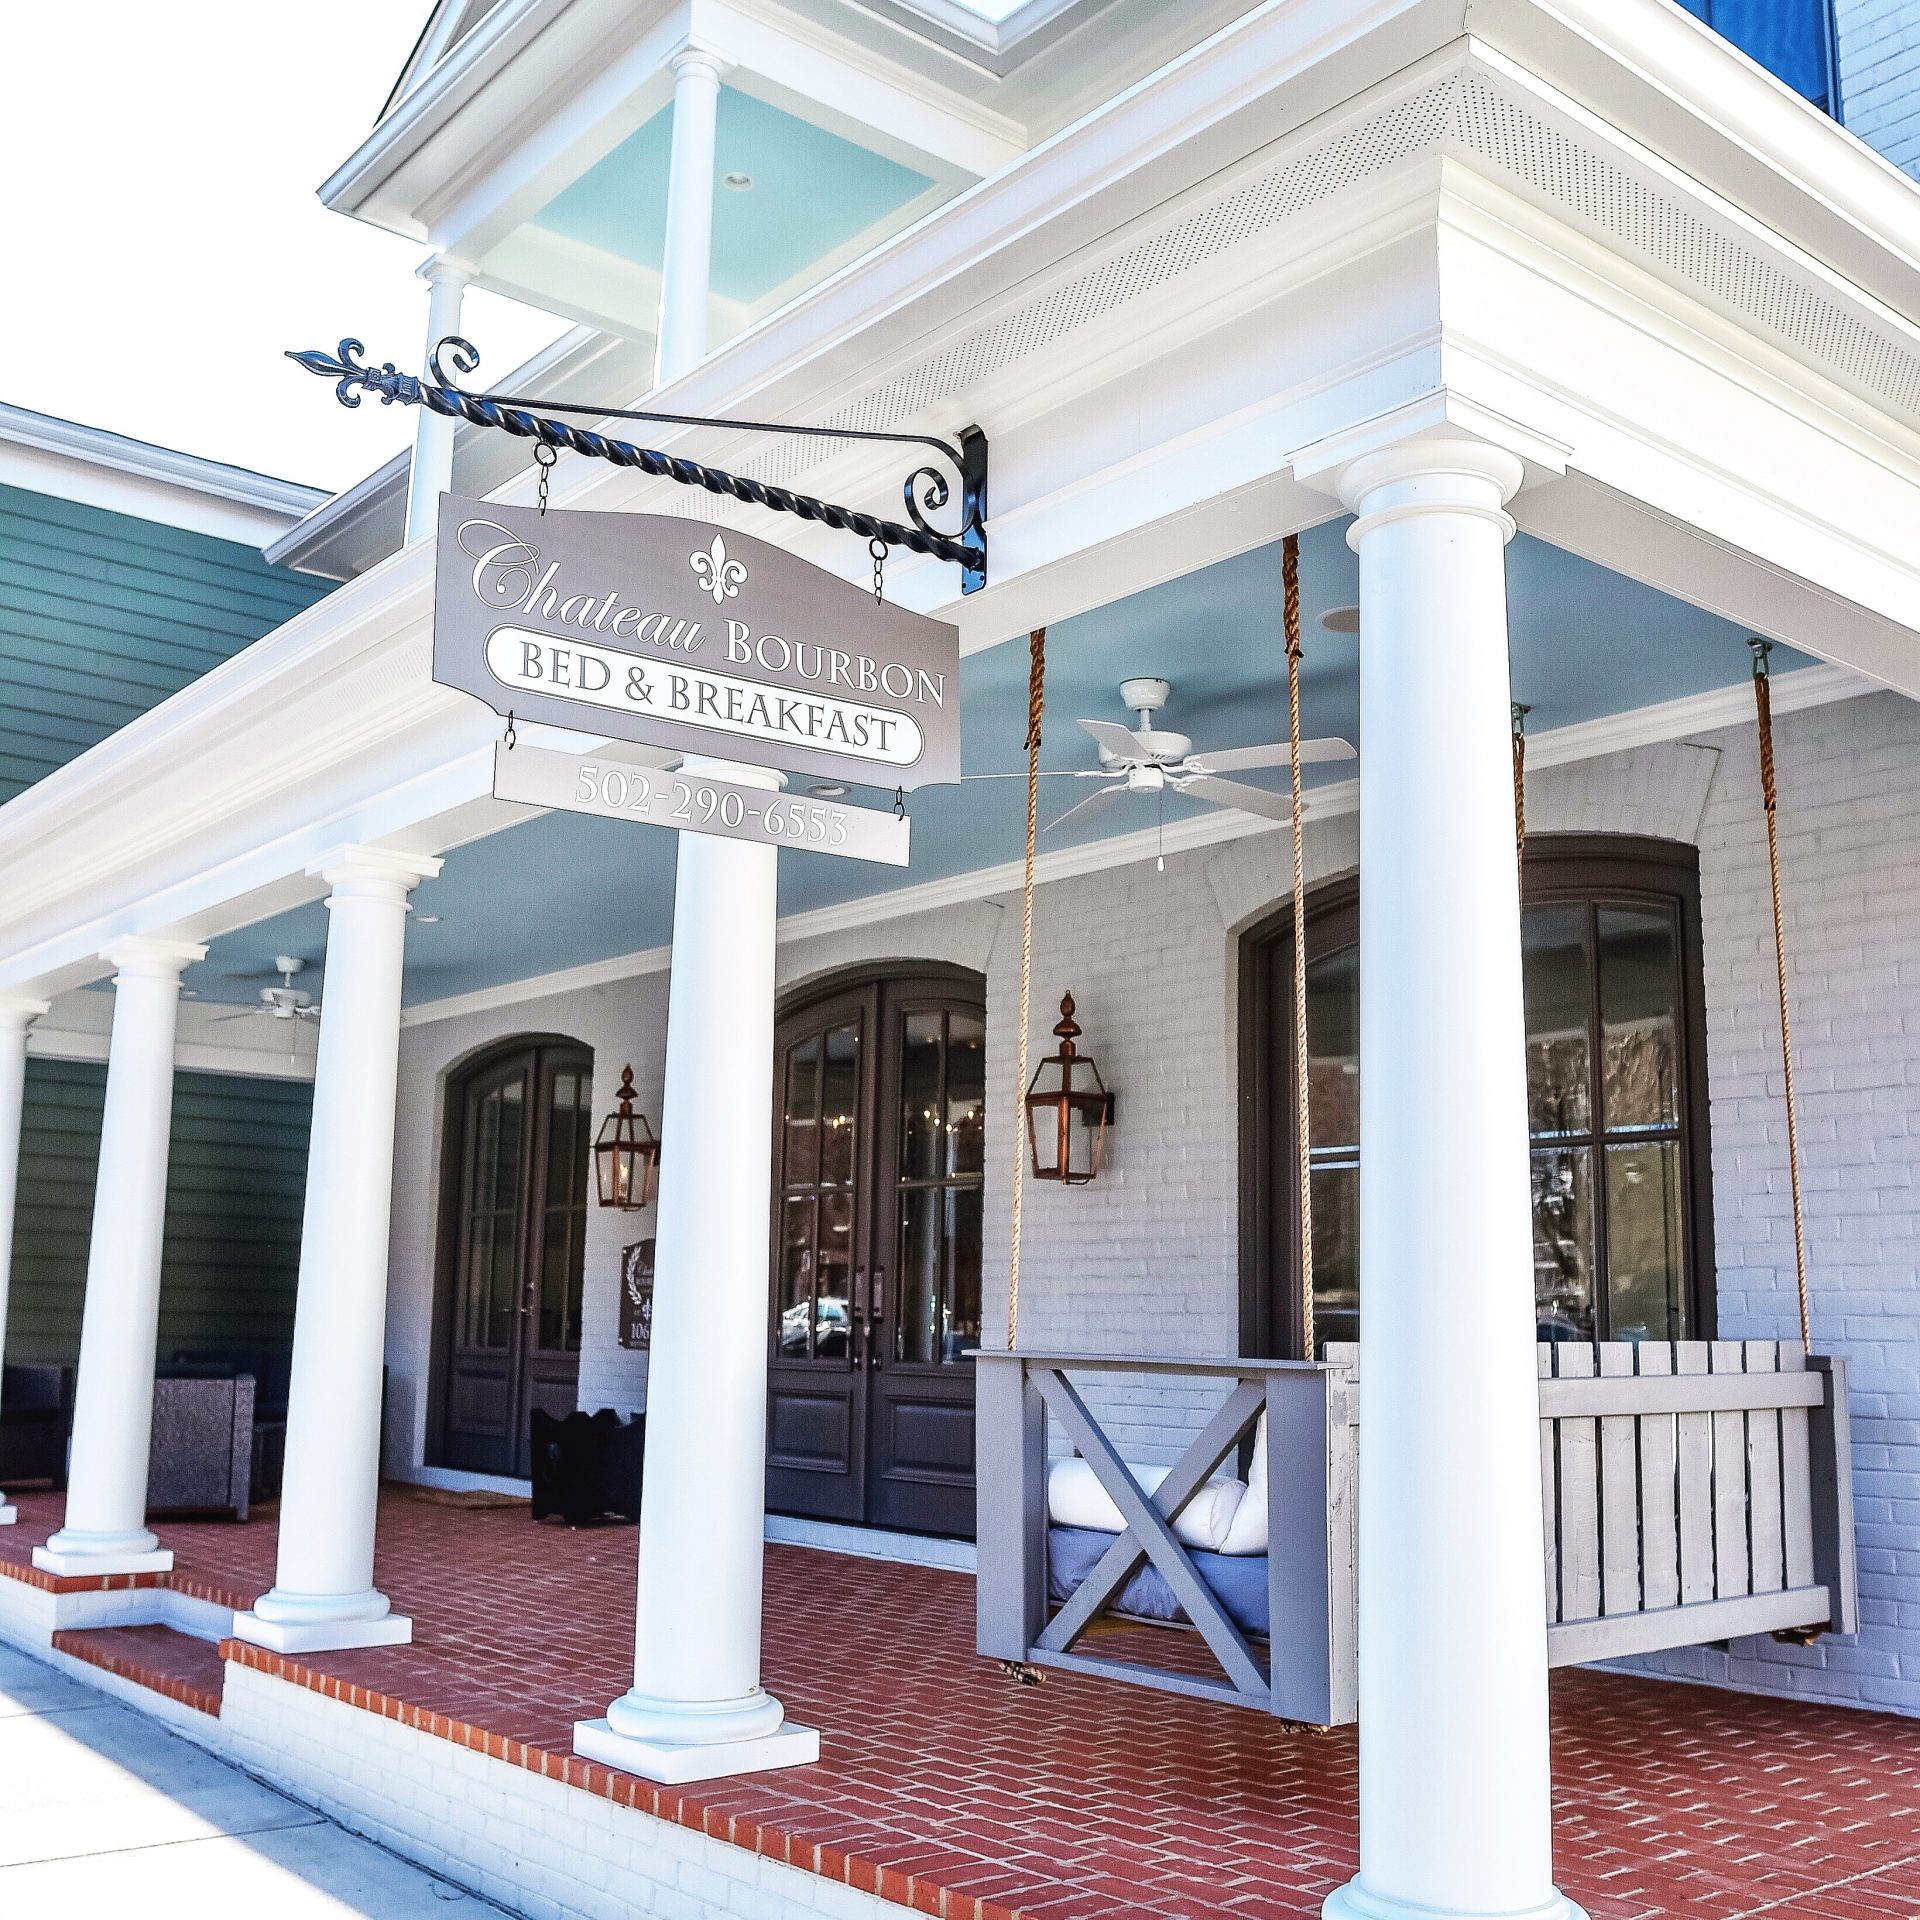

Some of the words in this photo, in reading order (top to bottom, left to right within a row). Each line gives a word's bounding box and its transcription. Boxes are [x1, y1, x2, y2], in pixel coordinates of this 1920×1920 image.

[457, 519, 706, 653] Chateau
[723, 619, 947, 709] BOURBON
[518, 640, 611, 692] BED
[624, 666, 655, 705] &
[667, 674, 898, 753] BREAKFAST
[575, 764, 850, 847] 502-290-6553
